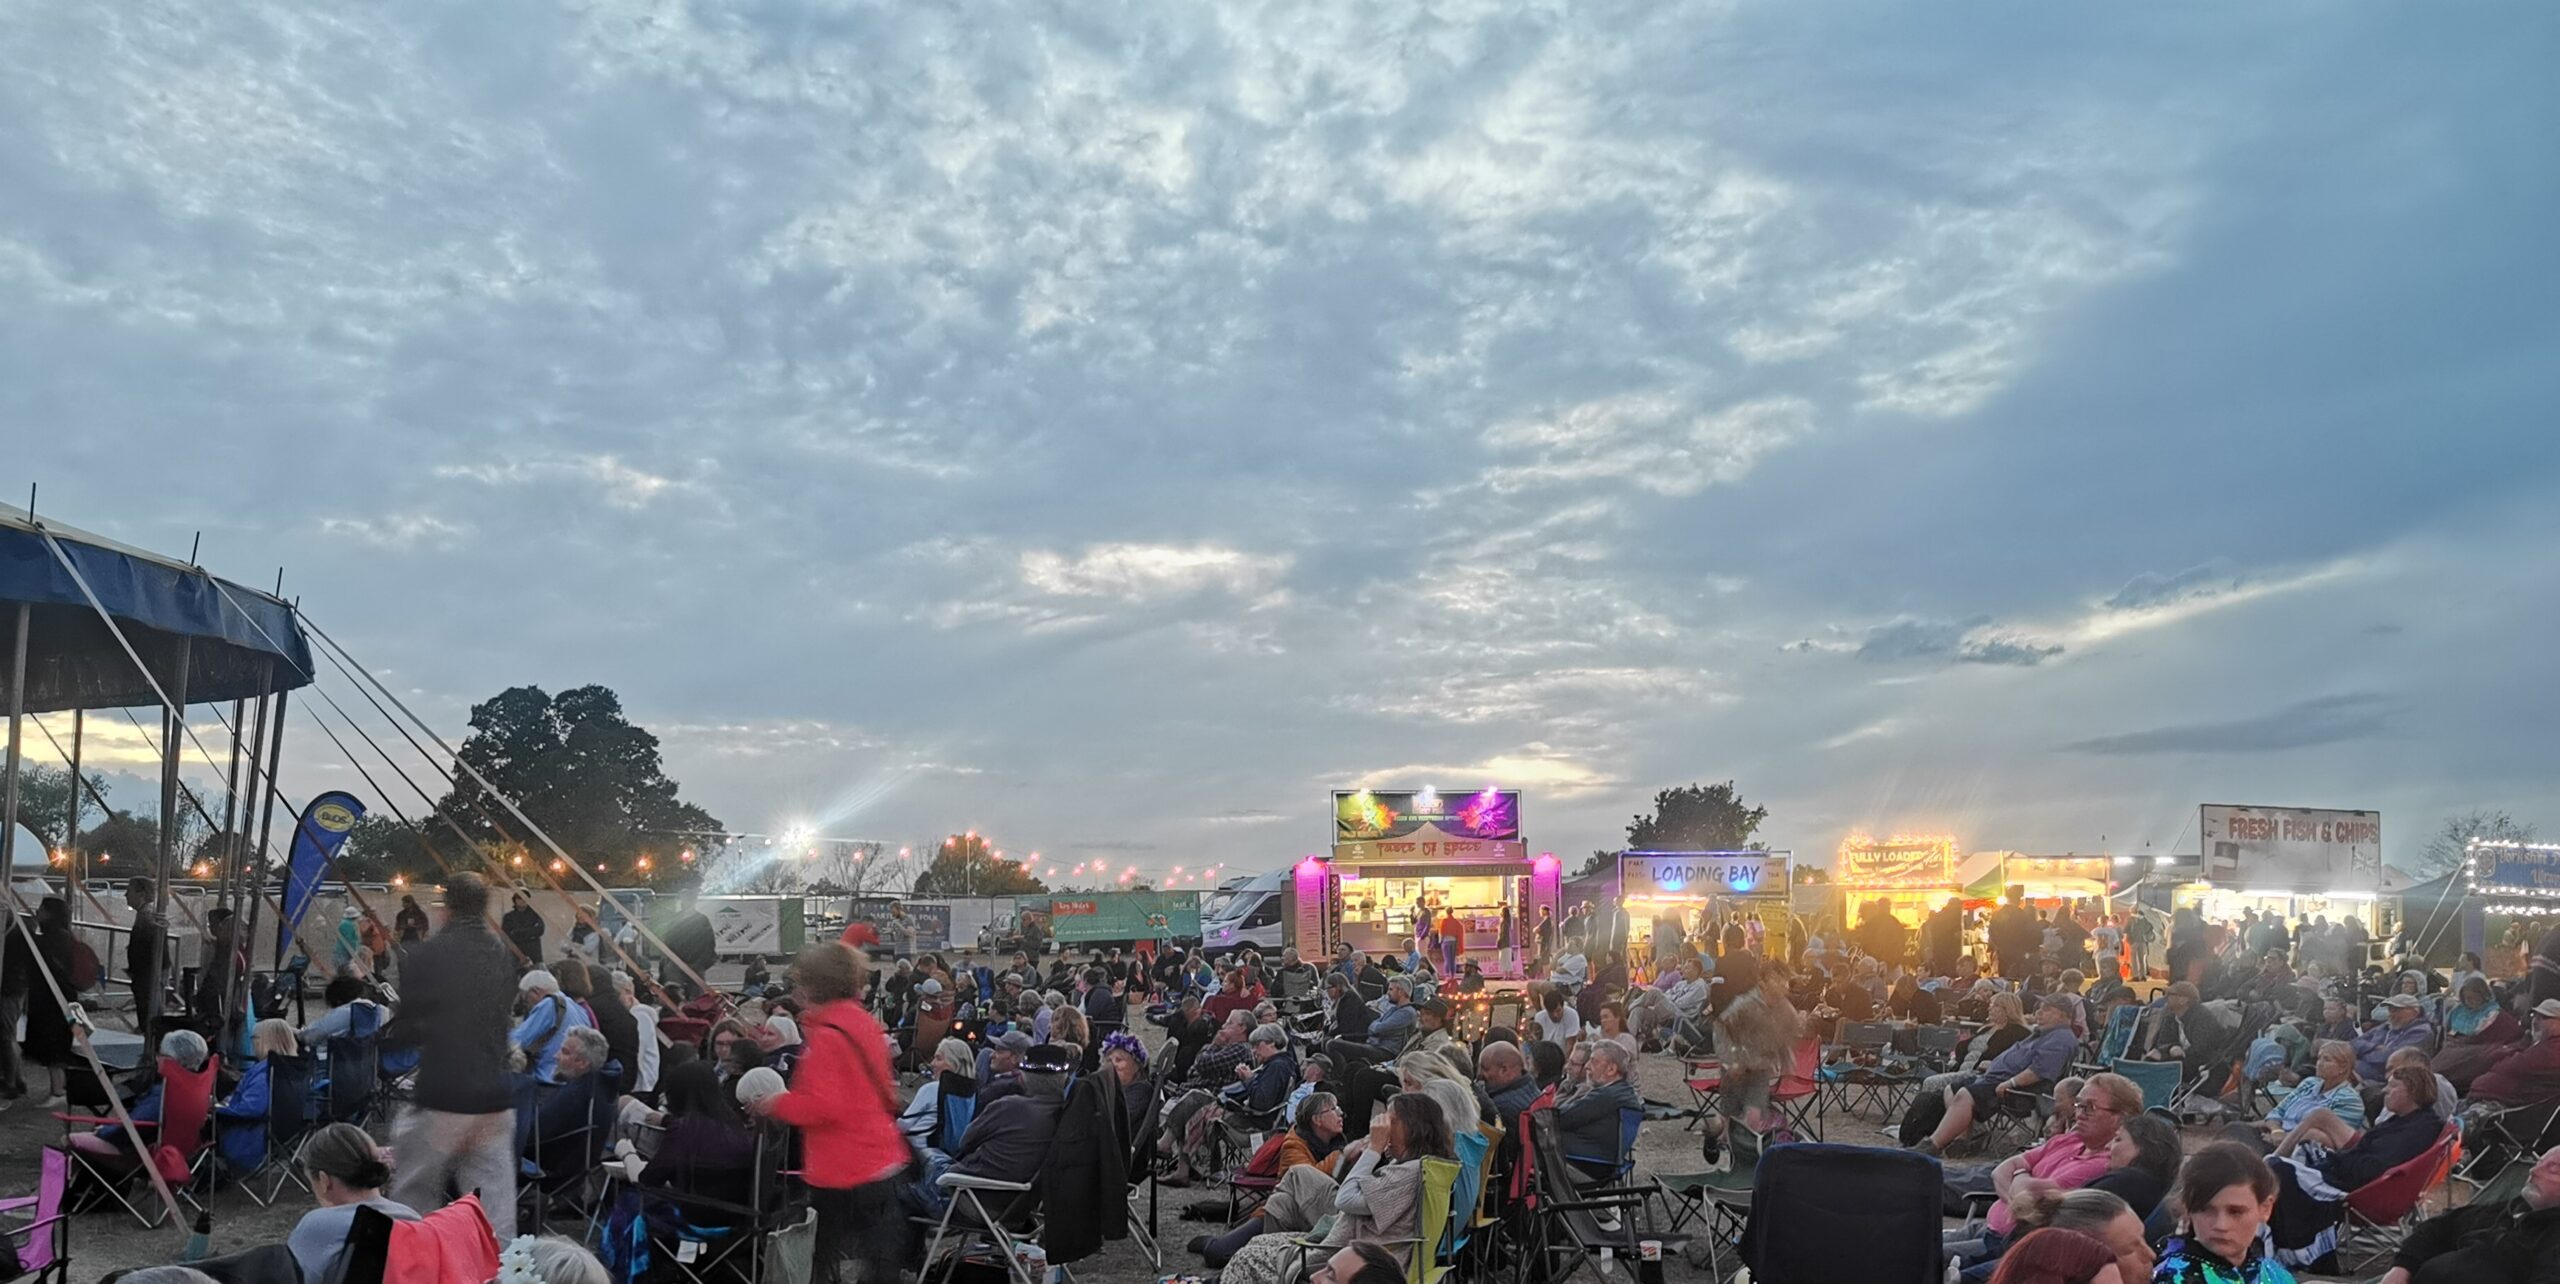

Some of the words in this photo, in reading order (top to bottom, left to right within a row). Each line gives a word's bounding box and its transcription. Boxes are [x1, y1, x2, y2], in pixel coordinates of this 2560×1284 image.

[2228, 817, 2278, 840] FRESH
[2283, 819, 2317, 842] FISH
[2321, 820, 2332, 843] &
[2335, 821, 2378, 844] CHIPS
[1851, 851, 1881, 862] FULLY
[1652, 865, 1724, 884] LOADING
[1728, 865, 1760, 884] BAY
